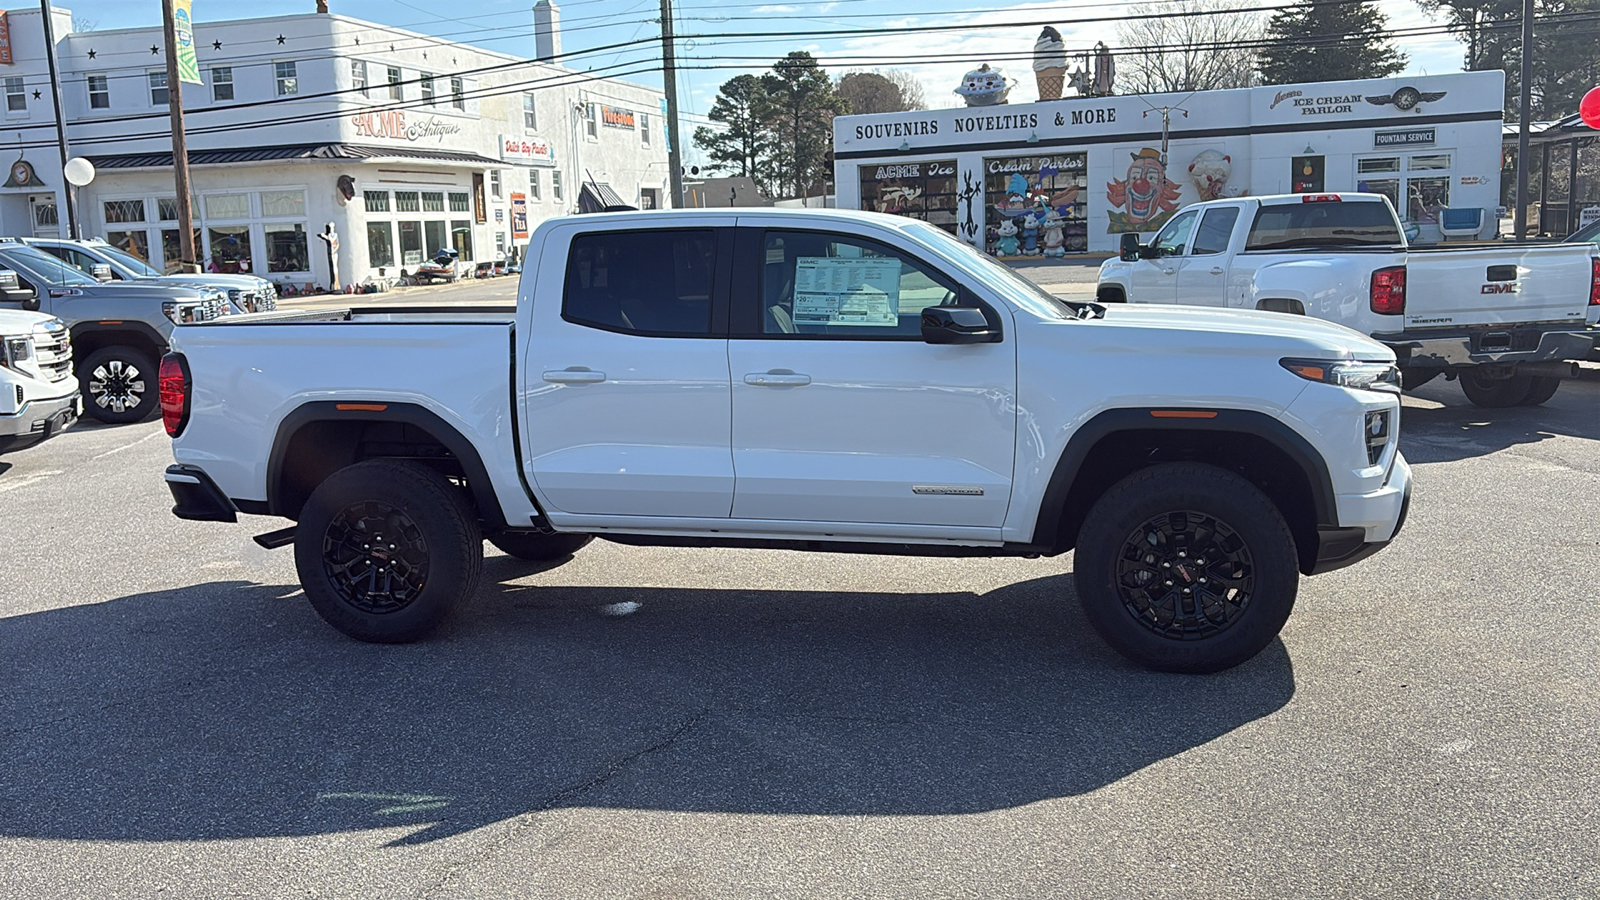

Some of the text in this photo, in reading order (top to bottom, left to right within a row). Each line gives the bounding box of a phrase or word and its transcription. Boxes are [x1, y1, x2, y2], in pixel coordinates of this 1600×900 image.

[1293, 95, 1362, 107] ICE CREAM
[1301, 105, 1352, 116] PARLOR
[351, 109, 408, 140] ACME
[855, 108, 1116, 140] SOUVENIRS NOVELTIES & MORE
[1376, 132, 1433, 144] FOUNTAIN SERVICE
[521, 141, 531, 157] Boy
[875, 163, 955, 179] ACME Ice
[989, 157, 1085, 174] Cream Parlor
[1481, 283, 1520, 294] GMC
